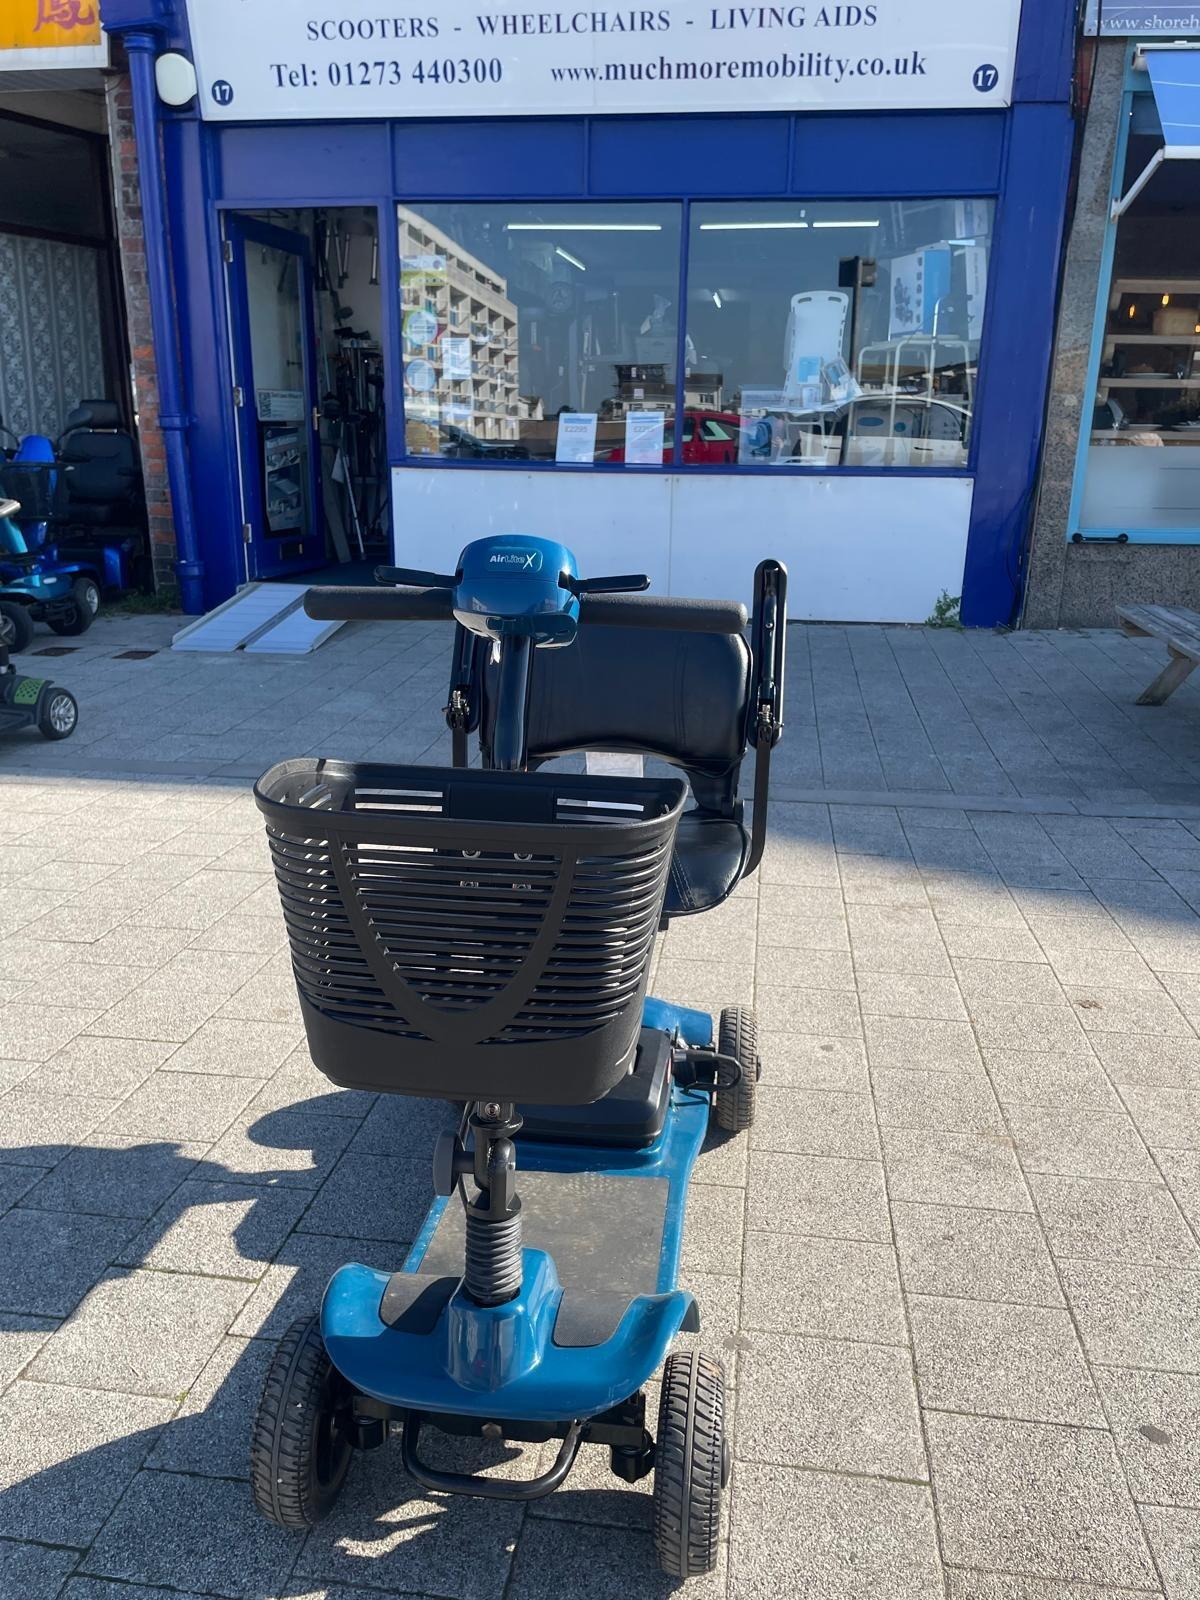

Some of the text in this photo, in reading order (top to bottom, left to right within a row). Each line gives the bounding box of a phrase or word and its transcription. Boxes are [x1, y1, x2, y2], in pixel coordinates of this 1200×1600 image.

[306, 16, 440, 41] SCOOTERS
[475, 9, 671, 36] WHEELCHAIRS
[710, 6, 806, 30] LIVING
[813, 4, 877, 28] AIDS
[269, 57, 503, 88] Tel: 01273 440300
[550, 50, 927, 84] www.muchmoremobility.co.uk
[976, 70, 996, 87] 17
[214, 85, 230, 101] 17
